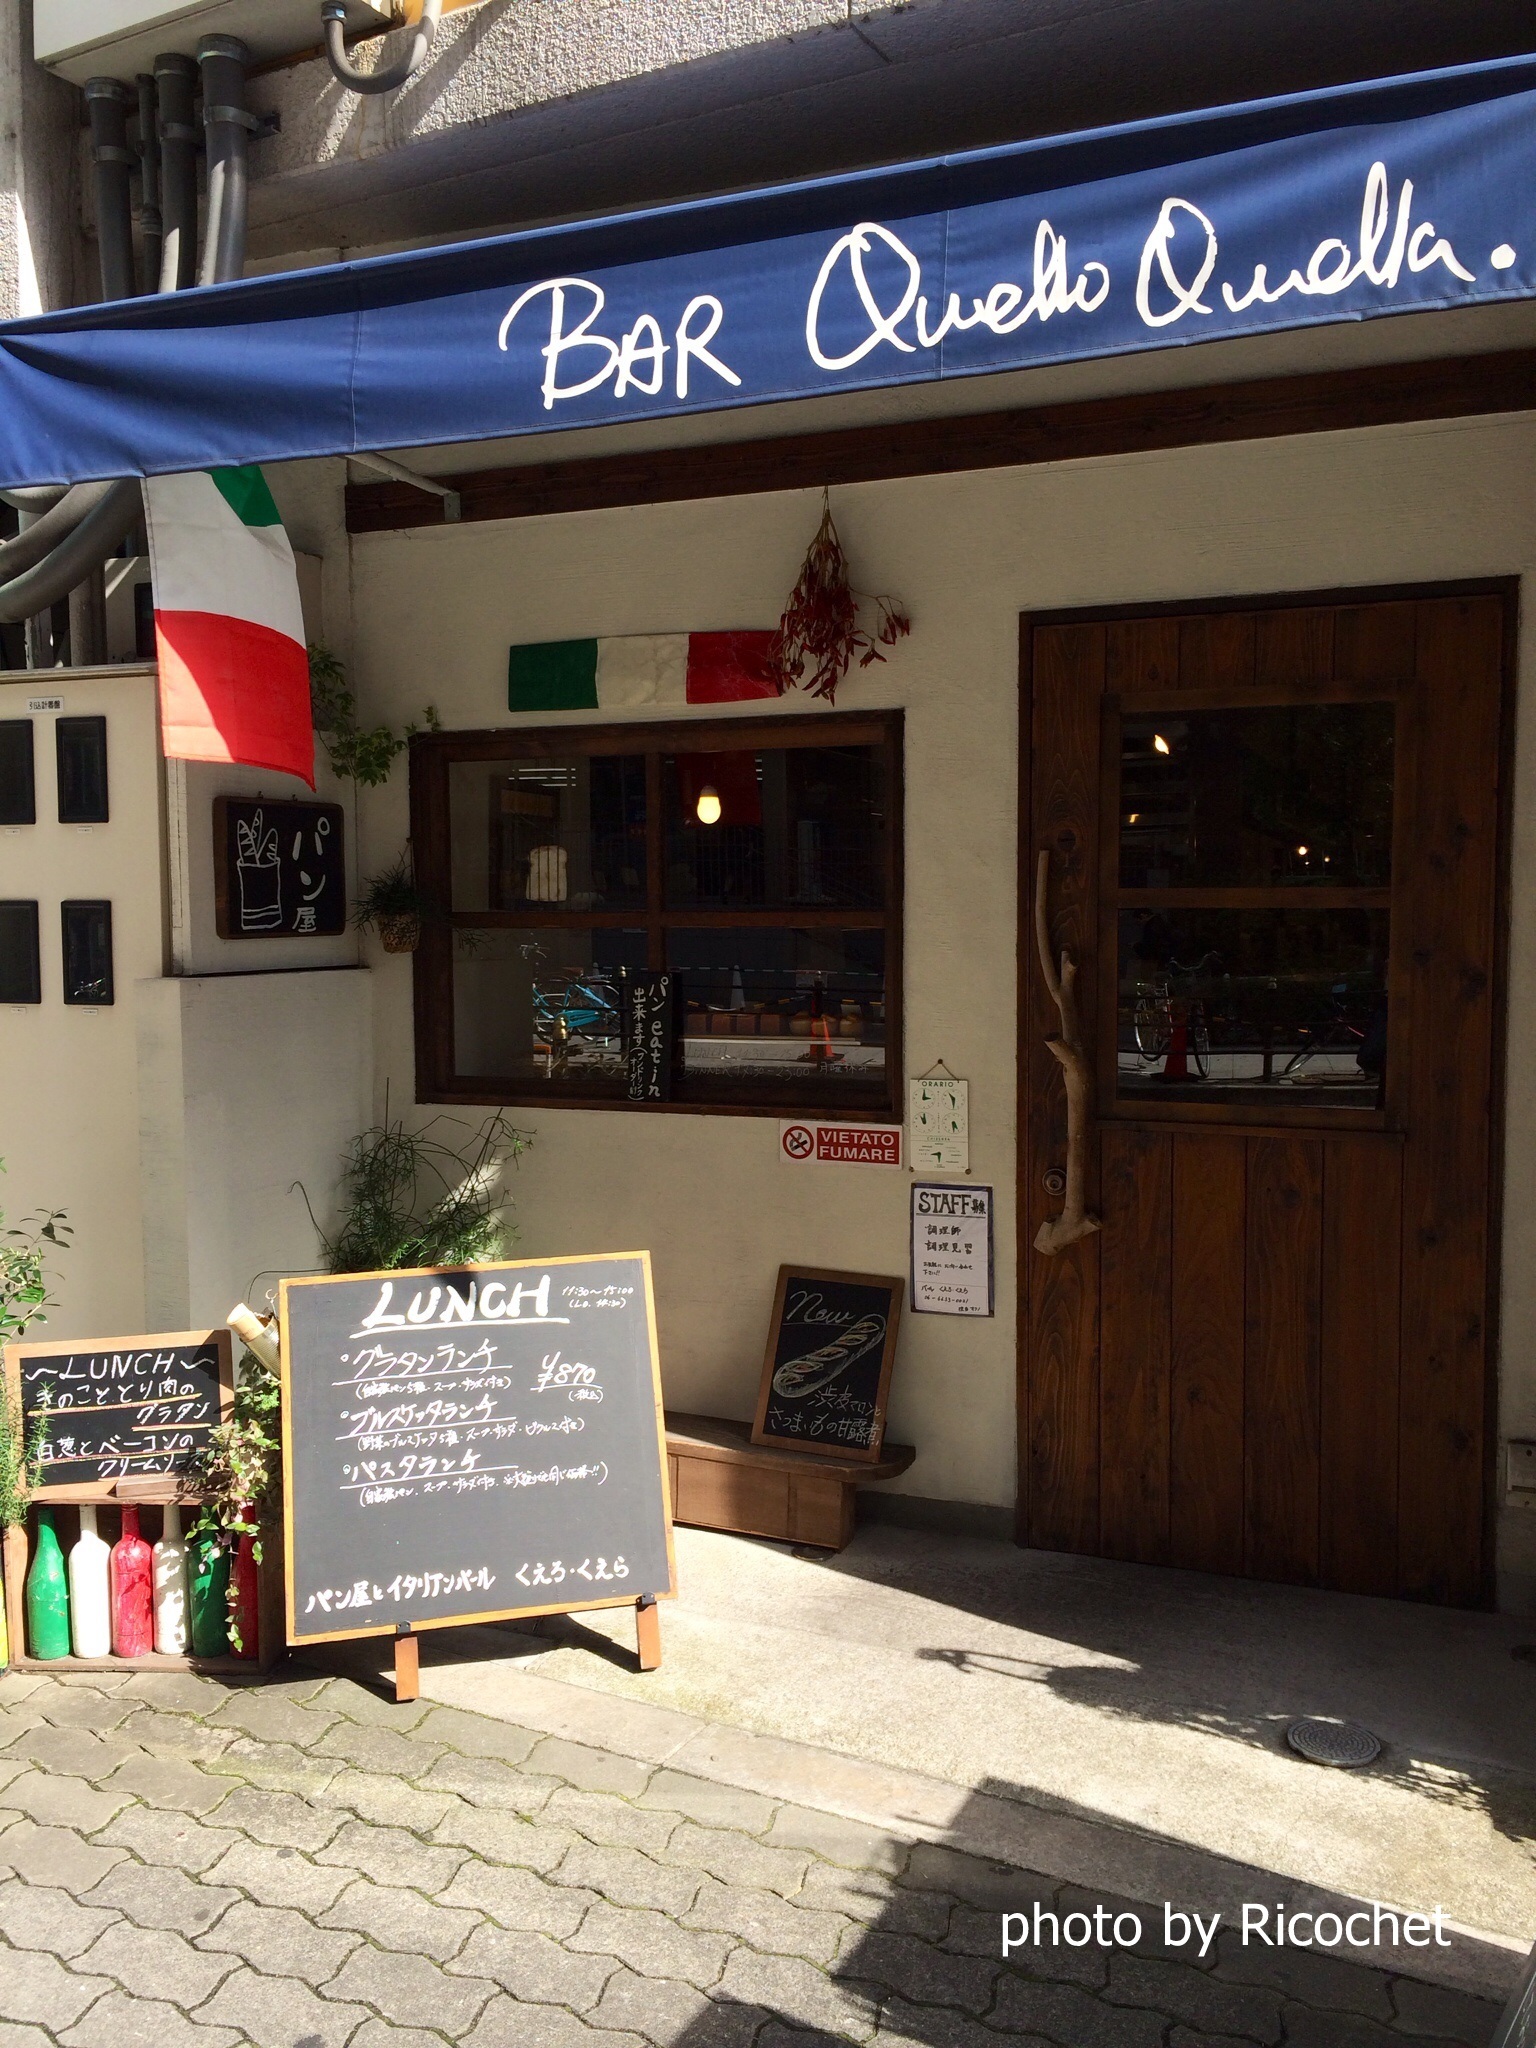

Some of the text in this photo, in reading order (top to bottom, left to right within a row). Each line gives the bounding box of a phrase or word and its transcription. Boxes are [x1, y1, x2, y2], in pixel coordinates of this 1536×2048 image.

[499, 276, 742, 411] BAR
[292, 816, 331, 933] パン屋
[649, 976, 669, 1012] パン
[820, 1130, 895, 1145] VIETATO
[819, 1146, 896, 1161] FUMARE
[918, 1191, 971, 1214] STAFF
[924, 1223, 962, 1236] 調理師
[924, 1240, 973, 1255] 調理見習
[361, 1275, 551, 1329] LUNCH
[787, 1291, 853, 1323] New
[537, 1351, 596, 1392] ¥870
[137, 1401, 210, 1424] グラタン
[38, 1434, 194, 1462] 白葱とベーコンの
[352, 1449, 481, 1482] パスタランチ
